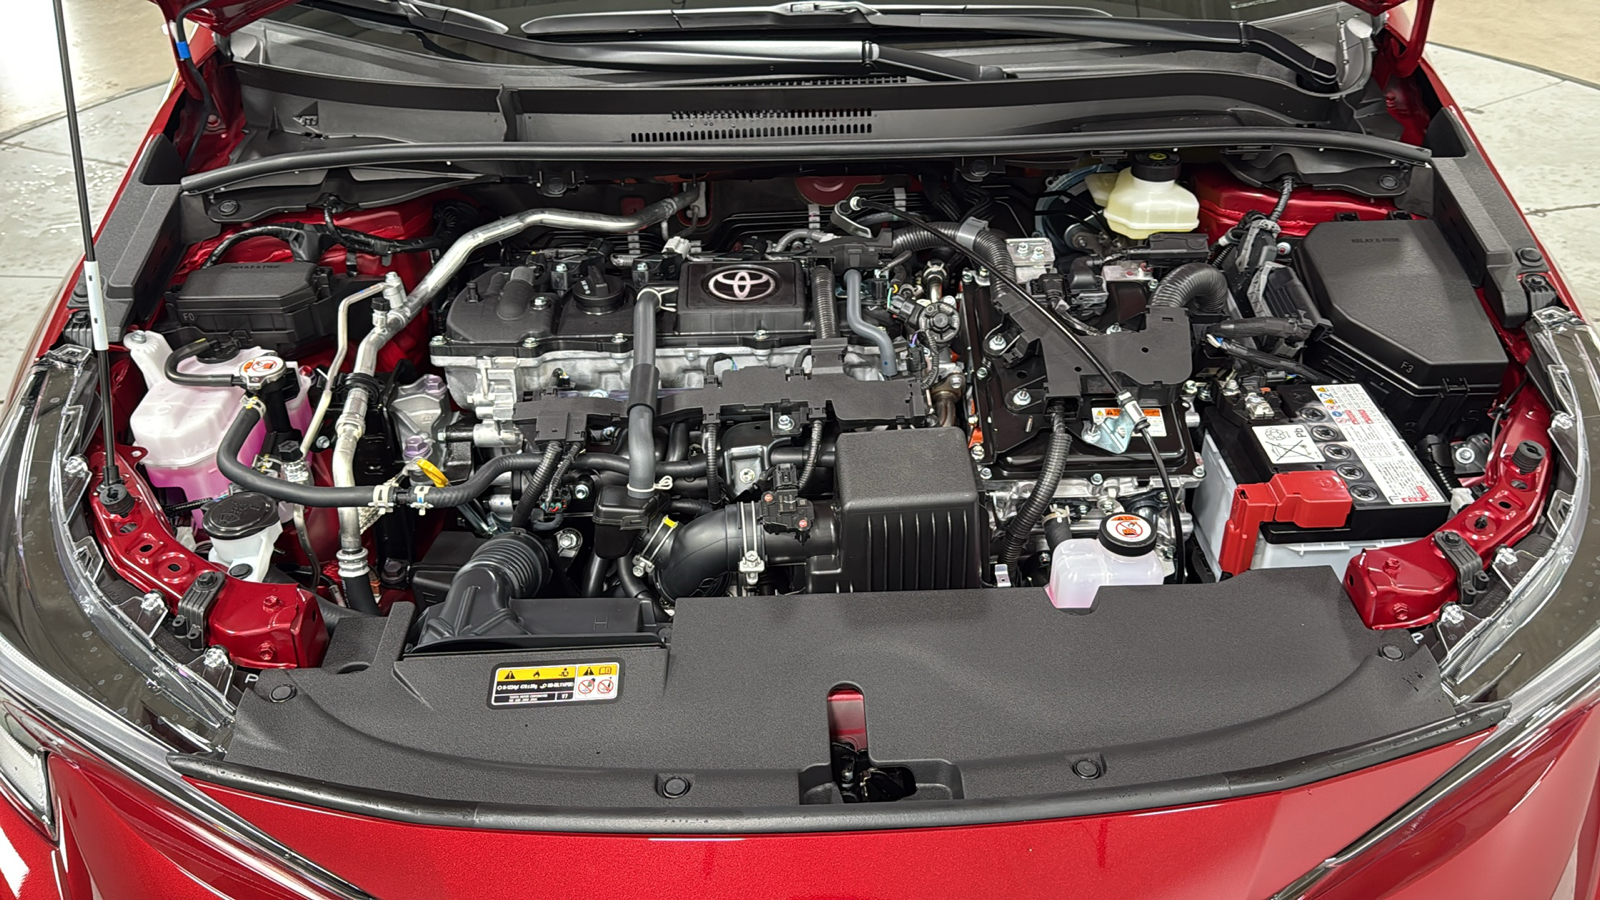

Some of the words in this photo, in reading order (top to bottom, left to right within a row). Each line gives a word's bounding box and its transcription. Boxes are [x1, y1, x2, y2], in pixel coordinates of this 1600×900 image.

[1401, 361, 1413, 374] F3
[1294, 428, 1307, 438] Pb
[244, 673, 259, 683] P
